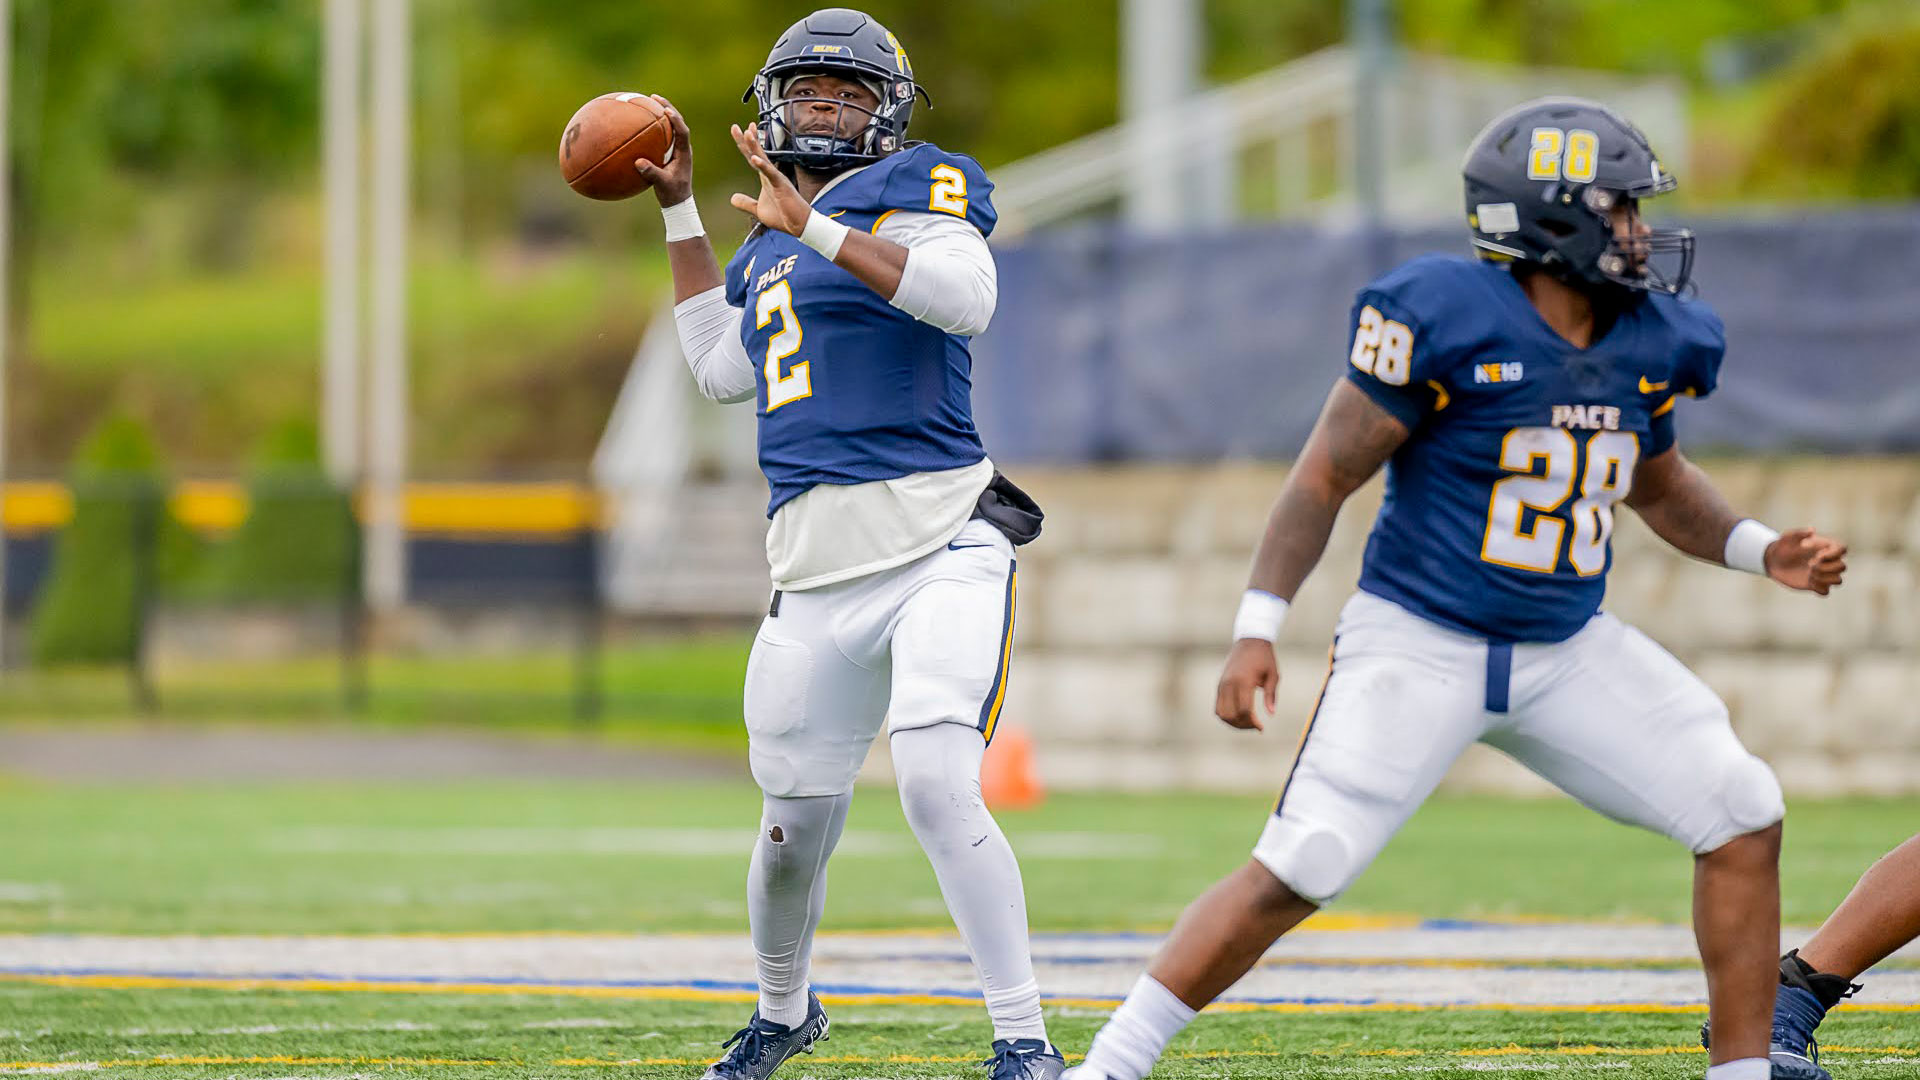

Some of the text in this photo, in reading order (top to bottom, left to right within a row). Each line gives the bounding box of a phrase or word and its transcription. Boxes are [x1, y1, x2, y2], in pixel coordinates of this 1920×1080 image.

[1527, 127, 1600, 183] 28
[929, 163, 968, 218] 2
[754, 254, 799, 293] PACE
[756, 278, 812, 412] 2
[1350, 304, 1415, 386] 28
[1551, 404, 1621, 430] PACE
[1480, 426, 1641, 577] 28
